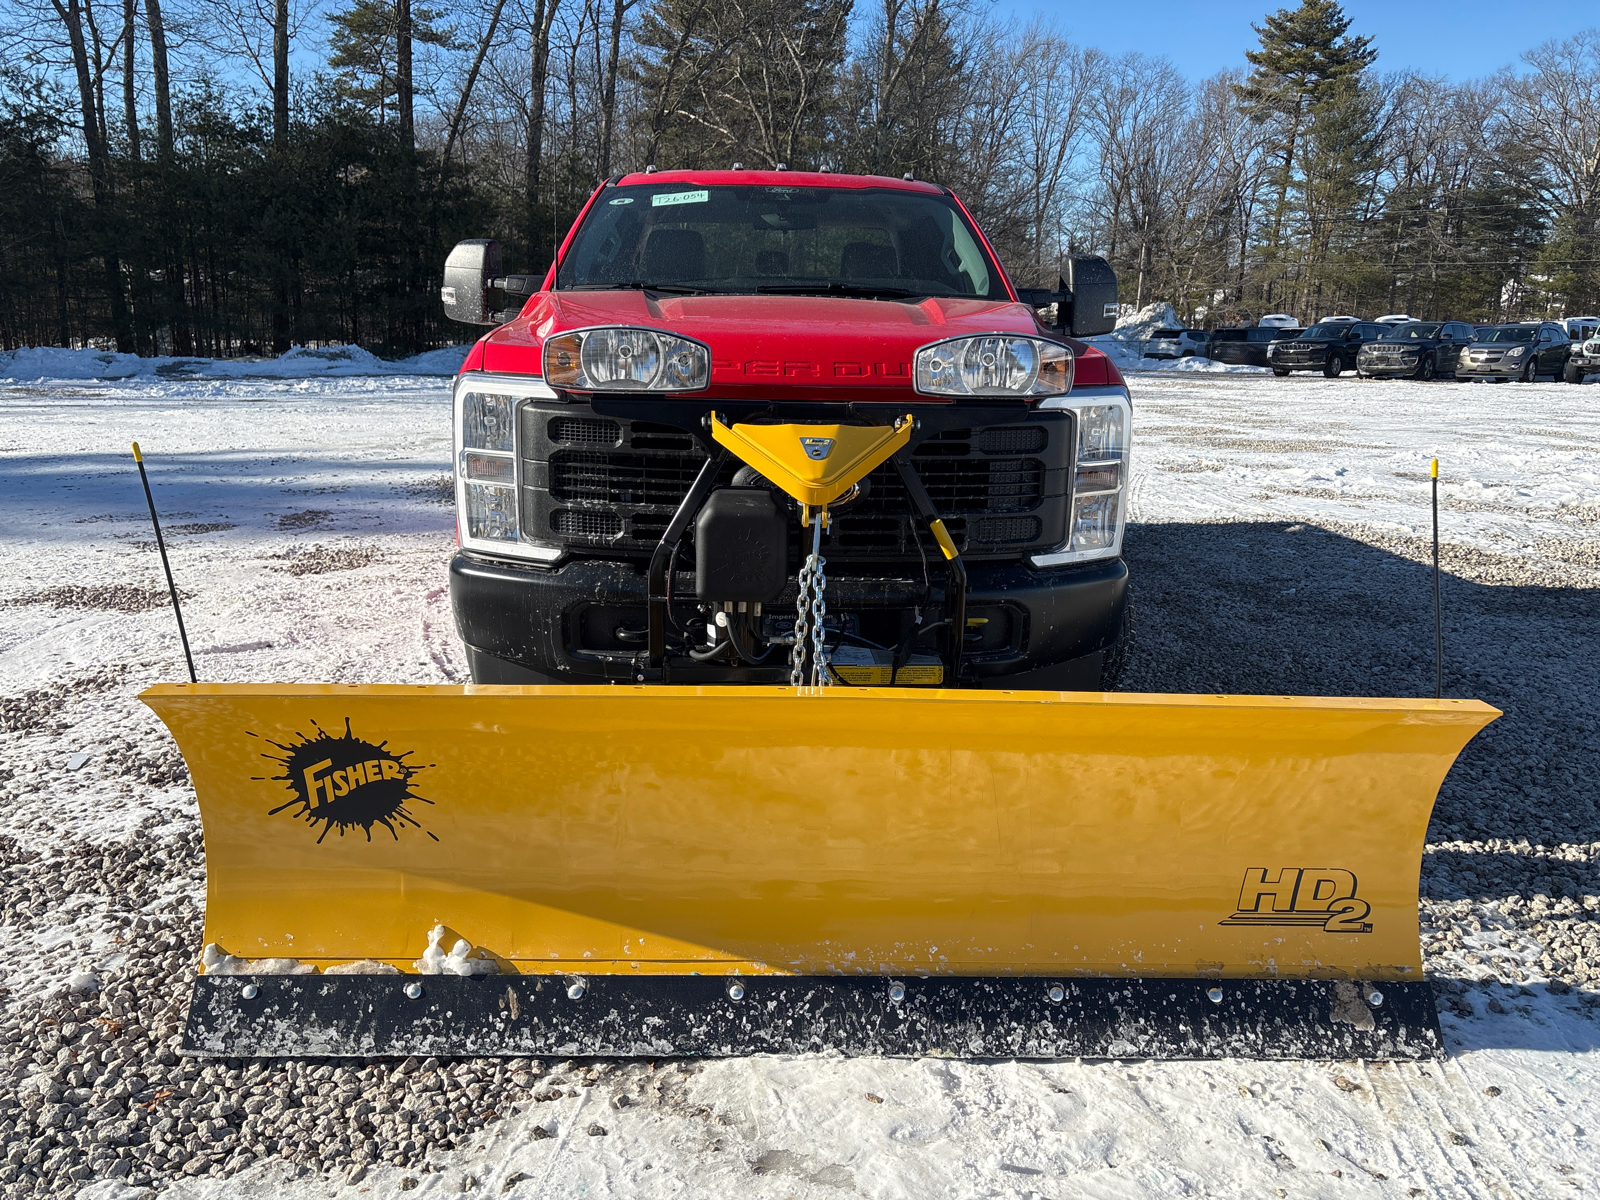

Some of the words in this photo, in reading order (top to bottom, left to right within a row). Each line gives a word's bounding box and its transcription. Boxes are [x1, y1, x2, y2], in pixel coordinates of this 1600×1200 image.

[711, 359, 820, 377] PER
[833, 361, 912, 379] DU
[303, 758, 404, 810] FISHER
